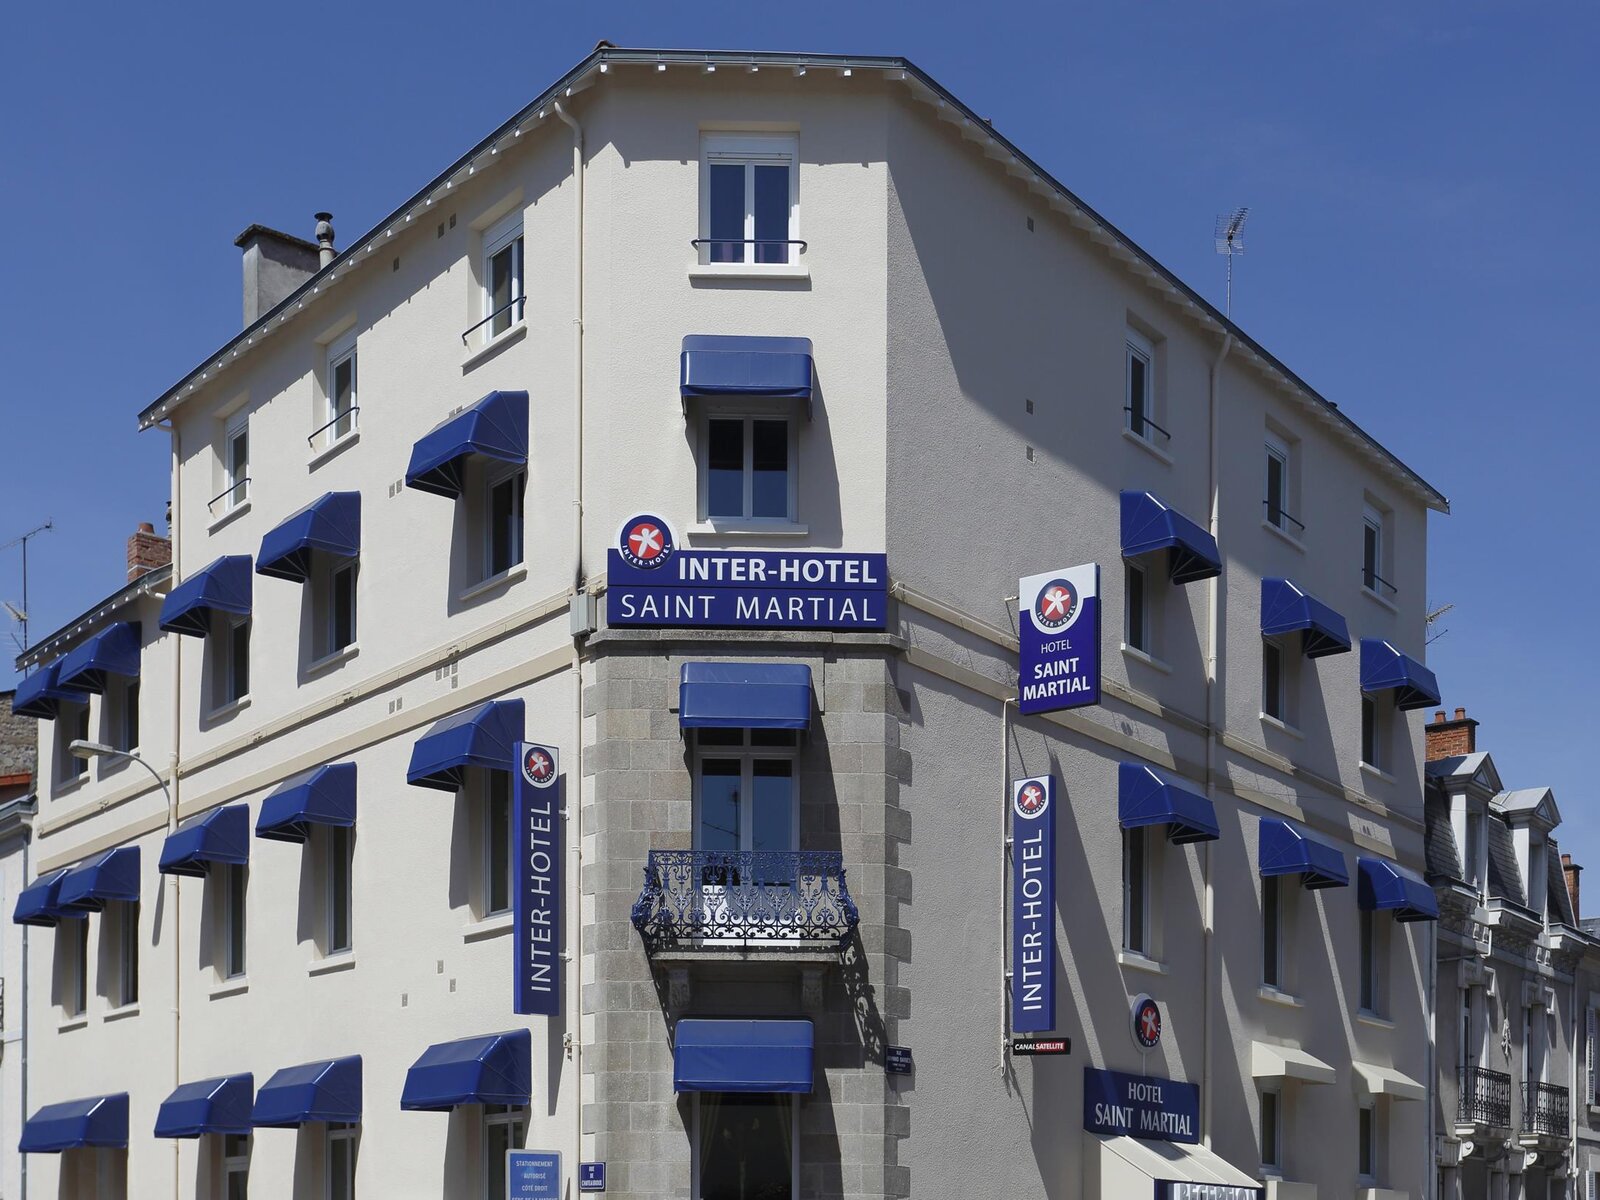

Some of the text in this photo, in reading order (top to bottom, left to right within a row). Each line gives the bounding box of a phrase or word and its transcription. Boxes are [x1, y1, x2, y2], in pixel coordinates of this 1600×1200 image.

[622, 543, 671, 566] INTER-HOTEL
[679, 557, 877, 583] INTER-HOTEL
[621, 594, 877, 622] SAINT MARTIAL
[1036, 604, 1077, 628] INTER-HOTEL
[1040, 639, 1072, 654] HOTEL
[1034, 657, 1080, 680] SAINT
[1023, 675, 1091, 701] MARTIAL
[530, 801, 551, 992] INTER-HOTEL
[1022, 829, 1042, 1011] INTER-HOTEL
[1128, 1082, 1163, 1103] HOTEL
[1095, 1103, 1193, 1136] SAINT MARTIAL
[515, 1160, 553, 1168] STATIONNEMENT
